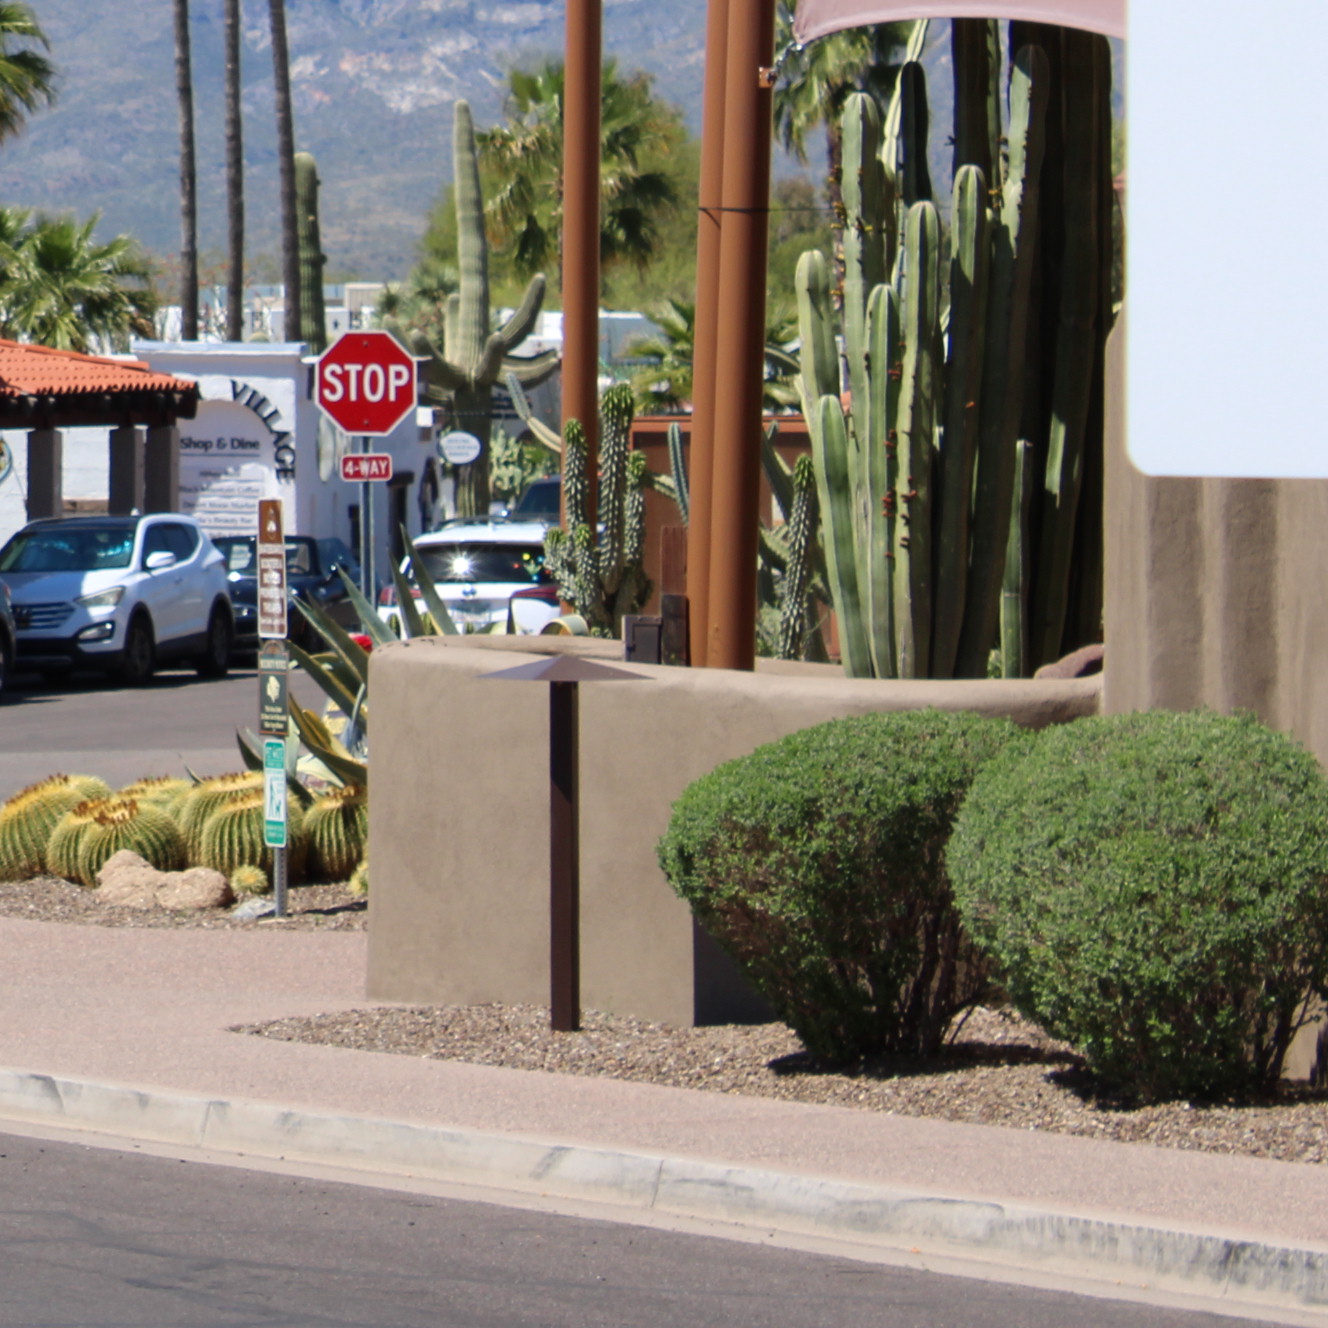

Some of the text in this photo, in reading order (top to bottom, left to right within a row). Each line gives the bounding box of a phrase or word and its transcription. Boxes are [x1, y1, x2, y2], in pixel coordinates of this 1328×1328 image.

[322, 363, 410, 402] STOP
[180, 437, 260, 452] Shop & Dine
[230, 378, 296, 485] VILLAGE
[344, 460, 388, 476] 4-WAY
